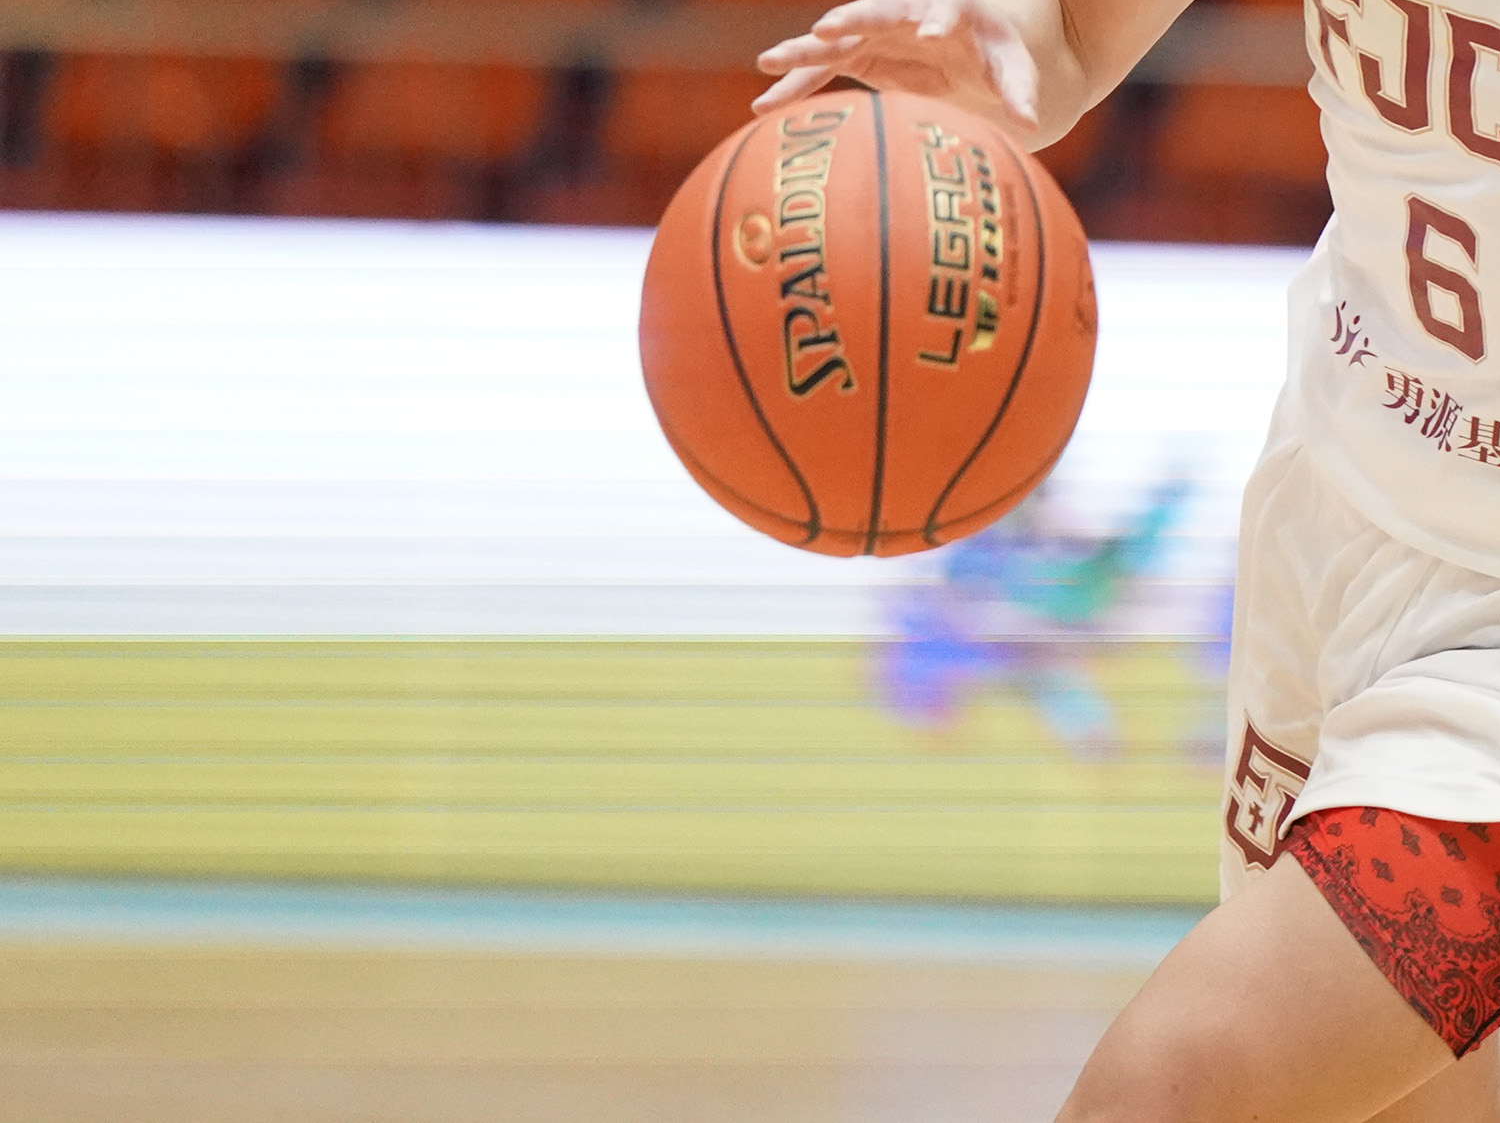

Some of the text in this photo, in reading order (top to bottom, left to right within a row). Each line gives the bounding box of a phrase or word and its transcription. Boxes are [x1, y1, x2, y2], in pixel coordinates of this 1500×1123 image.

[779, 106, 856, 397] SPALDING
[915, 123, 970, 368] LEGACY
[1404, 192, 1487, 365] 6
